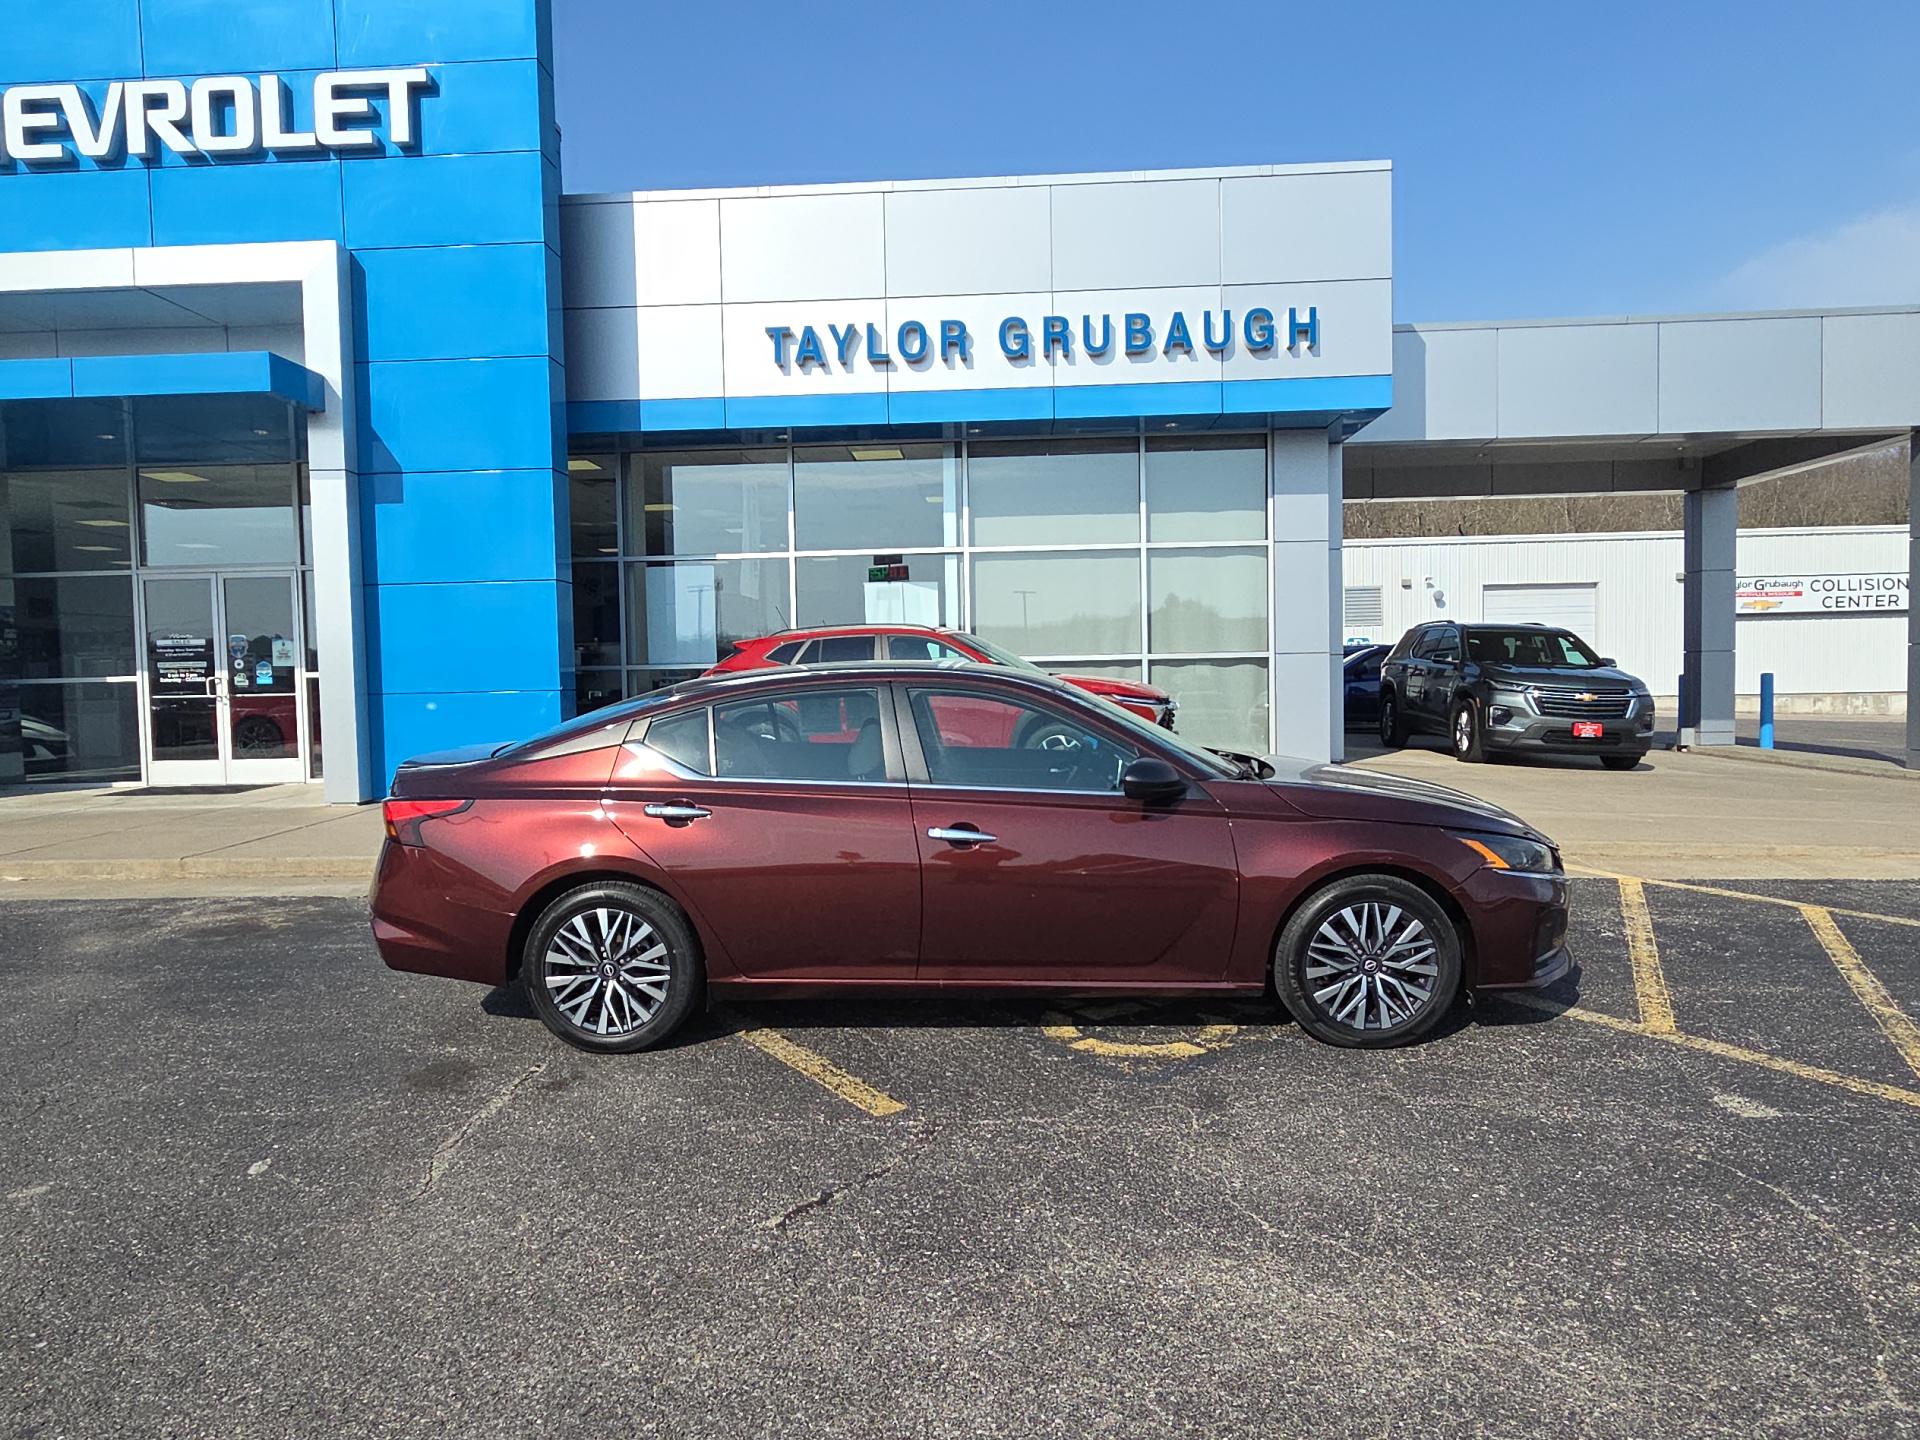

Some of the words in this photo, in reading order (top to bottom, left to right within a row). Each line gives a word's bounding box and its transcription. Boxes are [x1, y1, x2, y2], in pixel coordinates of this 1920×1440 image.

[765, 319, 970, 369] TAYLOR
[999, 306, 1317, 358] GRUBAUGH
[1754, 579, 1804, 591] Grubaugh
[1810, 577, 1910, 593] COLLISION
[1822, 594, 1900, 609] CENTER
